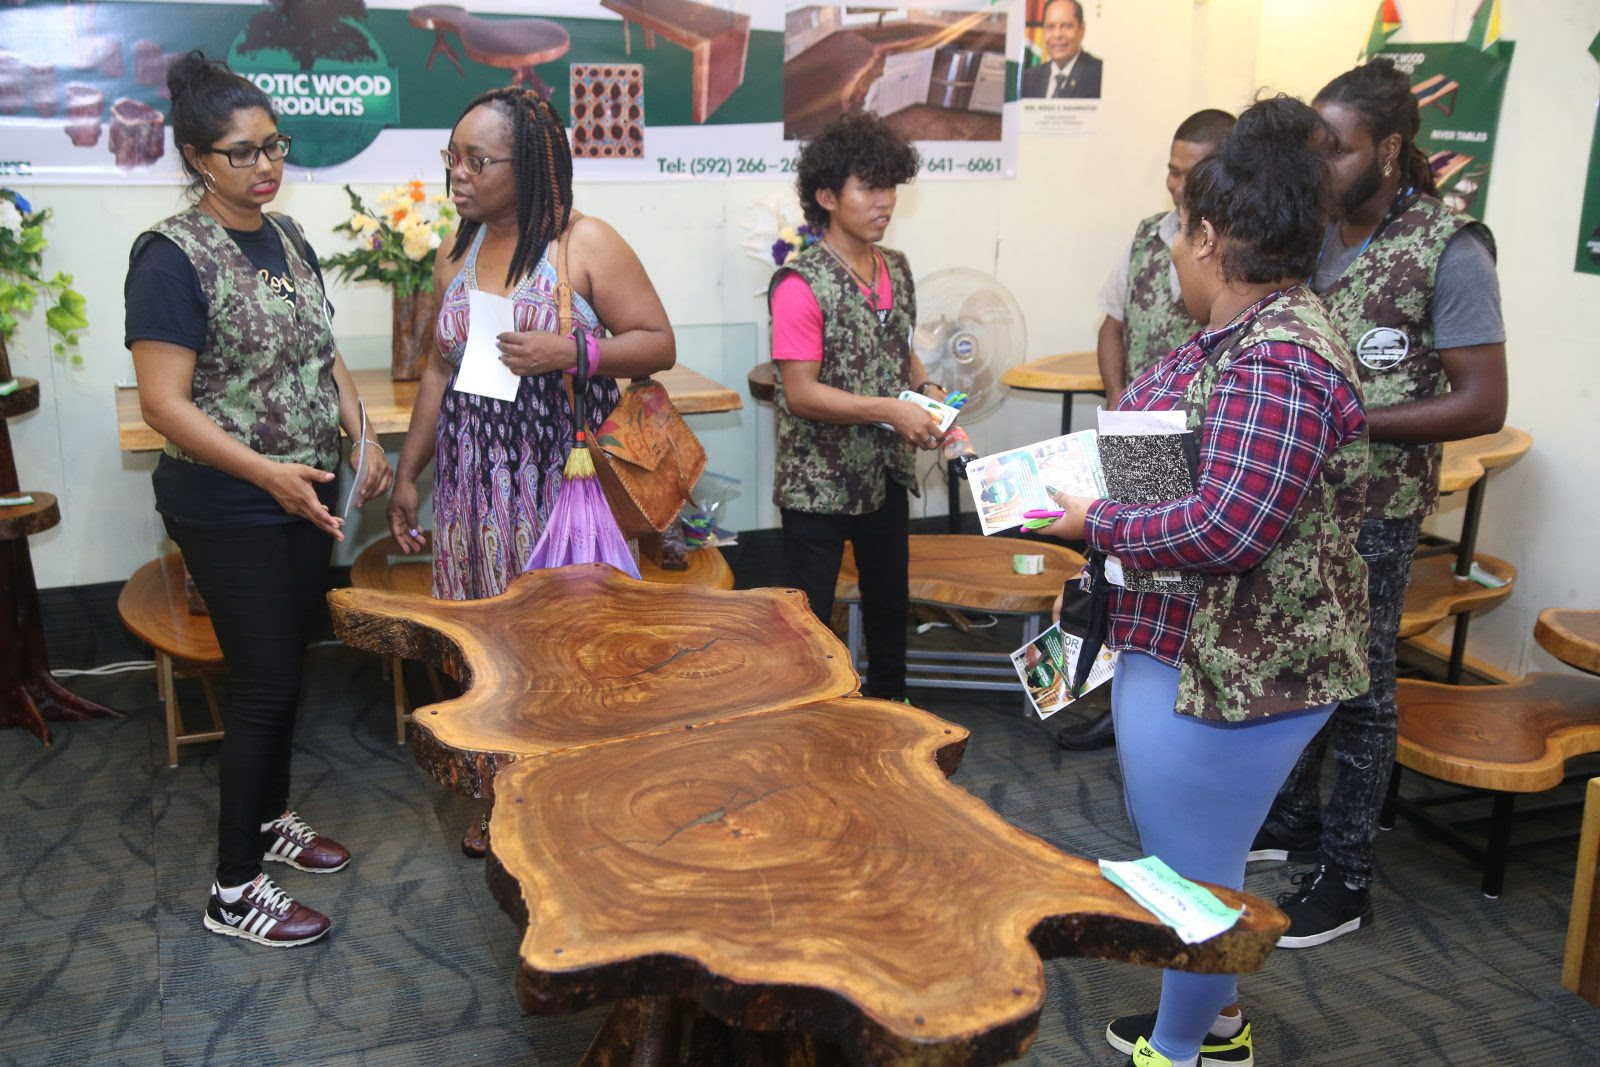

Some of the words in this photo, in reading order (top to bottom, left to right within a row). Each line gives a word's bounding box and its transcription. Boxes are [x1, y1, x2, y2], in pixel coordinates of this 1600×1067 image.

[239, 73, 310, 96] OTIC
[311, 74, 392, 96] WOOD
[271, 96, 365, 117] RODUCTS
[657, 158, 686, 173] Tel:
[690, 158, 732, 177] (592)
[736, 158, 800, 173] 266-26
